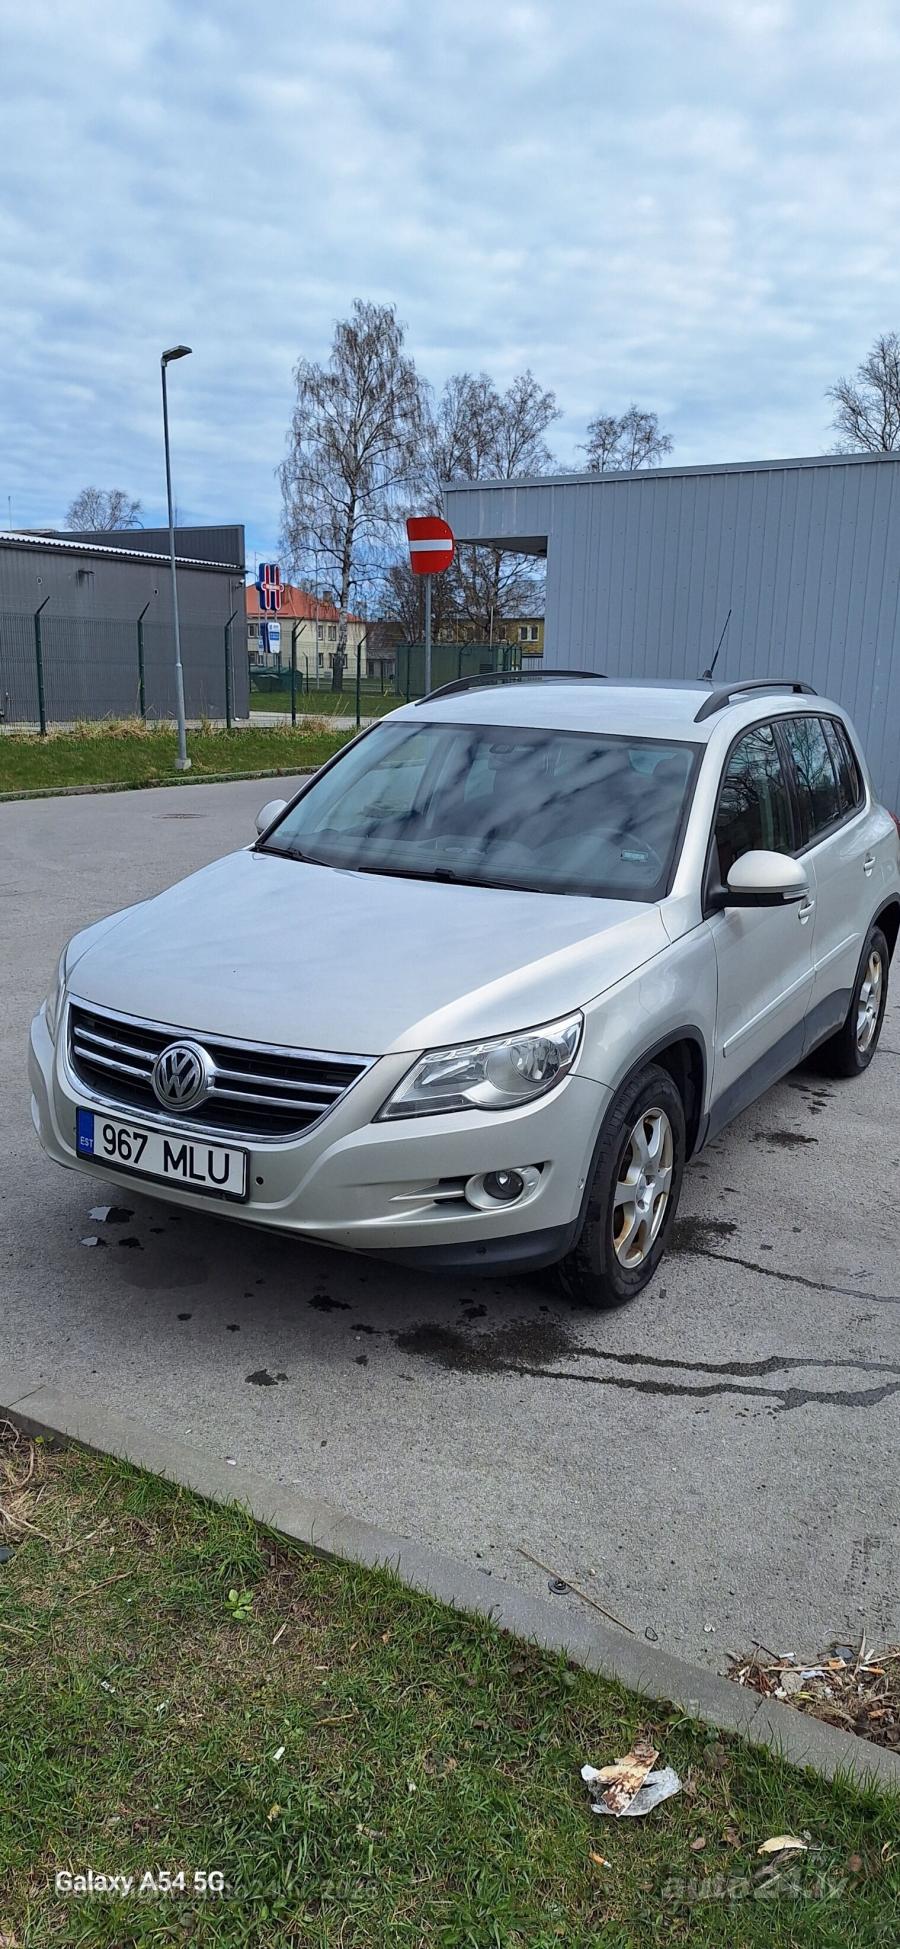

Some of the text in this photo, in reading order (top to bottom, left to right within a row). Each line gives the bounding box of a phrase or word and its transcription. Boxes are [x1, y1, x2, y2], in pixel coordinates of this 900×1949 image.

[80, 1135, 94, 1148] EST
[103, 1123, 230, 1184] 967 MLU
